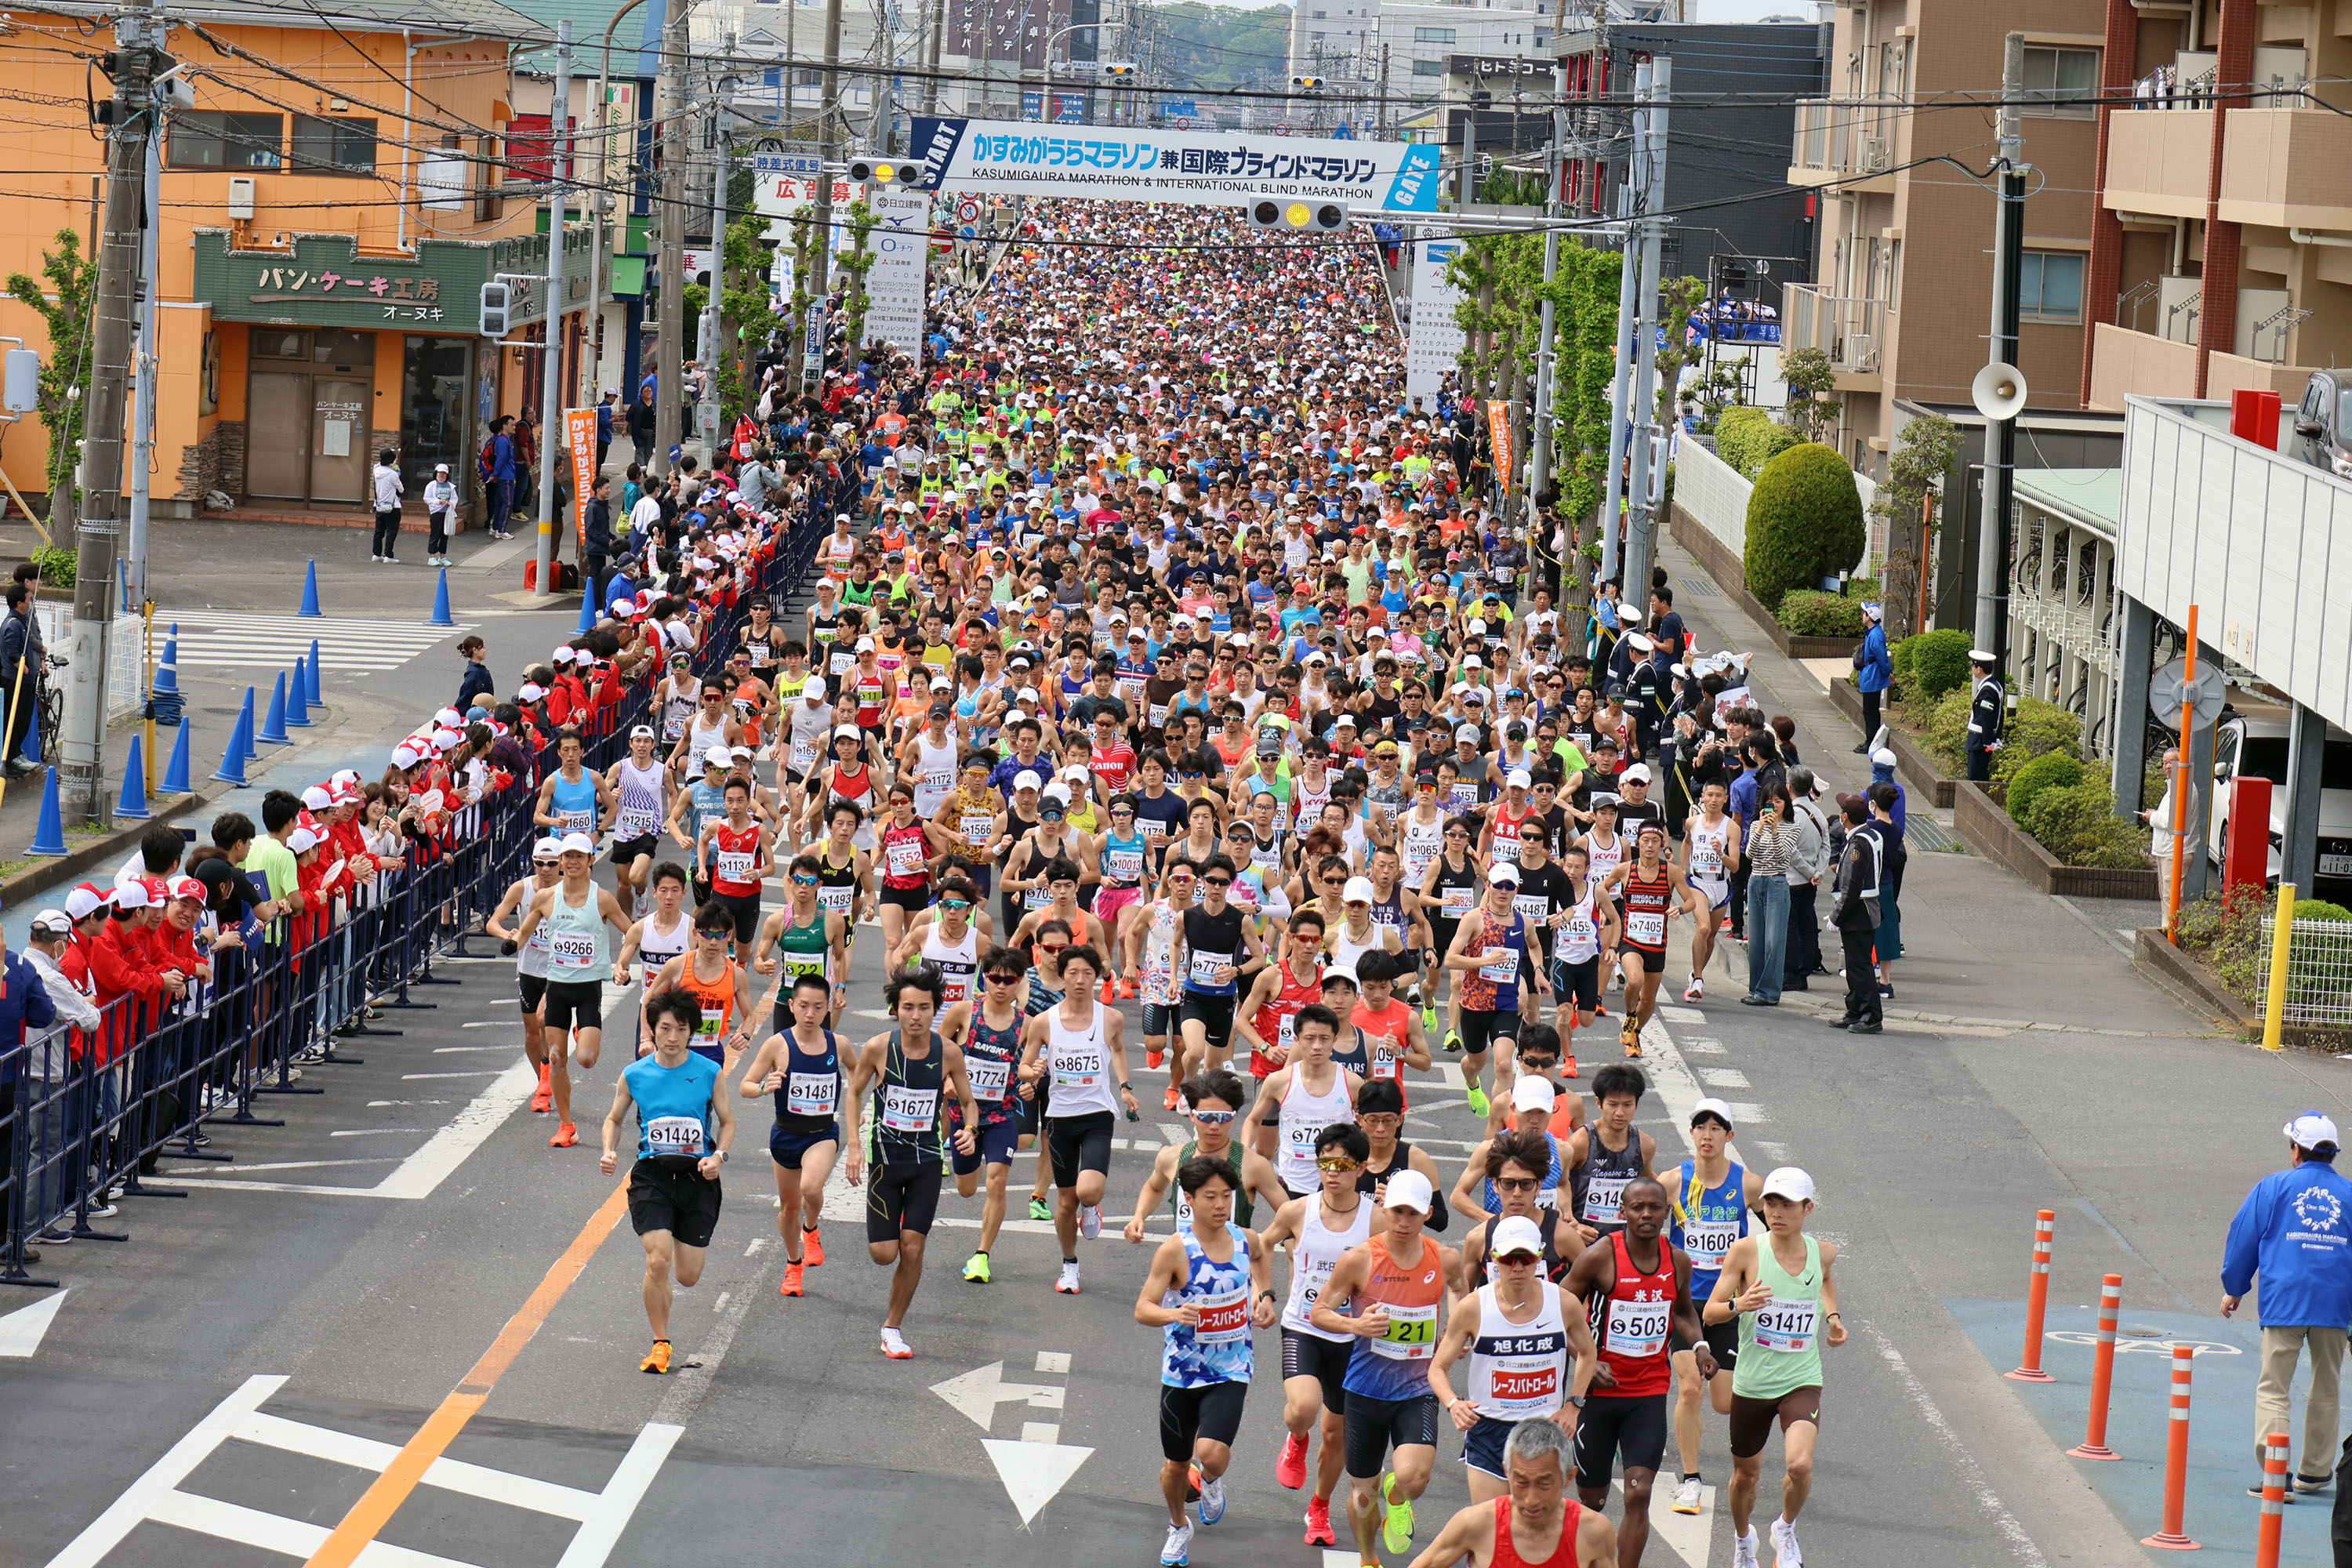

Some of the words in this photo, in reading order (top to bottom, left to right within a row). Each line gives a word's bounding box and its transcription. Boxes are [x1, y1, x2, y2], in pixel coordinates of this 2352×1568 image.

[924, 122, 958, 185] START
[757, 157, 820, 172] 時差式信号
[971, 167, 1065, 182] KASUMIGAURA
[1069, 172, 1140, 186] MARATHON
[1144, 176, 1152, 187] &
[1156, 177, 1257, 193] INTERNATIONAL
[1261, 183, 1298, 195] BLIND
[1302, 186, 1373, 199] MARATHON
[1395, 154, 1431, 206] GATE
[889, 199, 923, 209] 日立建機
[259, 267, 439, 300] パン・ケーキ工房
[383, 305, 445, 322] オーヌキ
[324, 411, 358, 421] オーヌキ
[1087, 761, 1124, 771] Canon
[645, 953, 671, 963] 旭化
[974, 1041, 1009, 1055] SAYSKY
[1684, 1205, 1739, 1221] 松戸陸協
[1634, 1288, 1663, 1302] 米沢
[1398, 1320, 1426, 1341] 21
[1492, 1336, 1554, 1354] 旭化成
[1528, 1396, 1548, 1408] 2024
